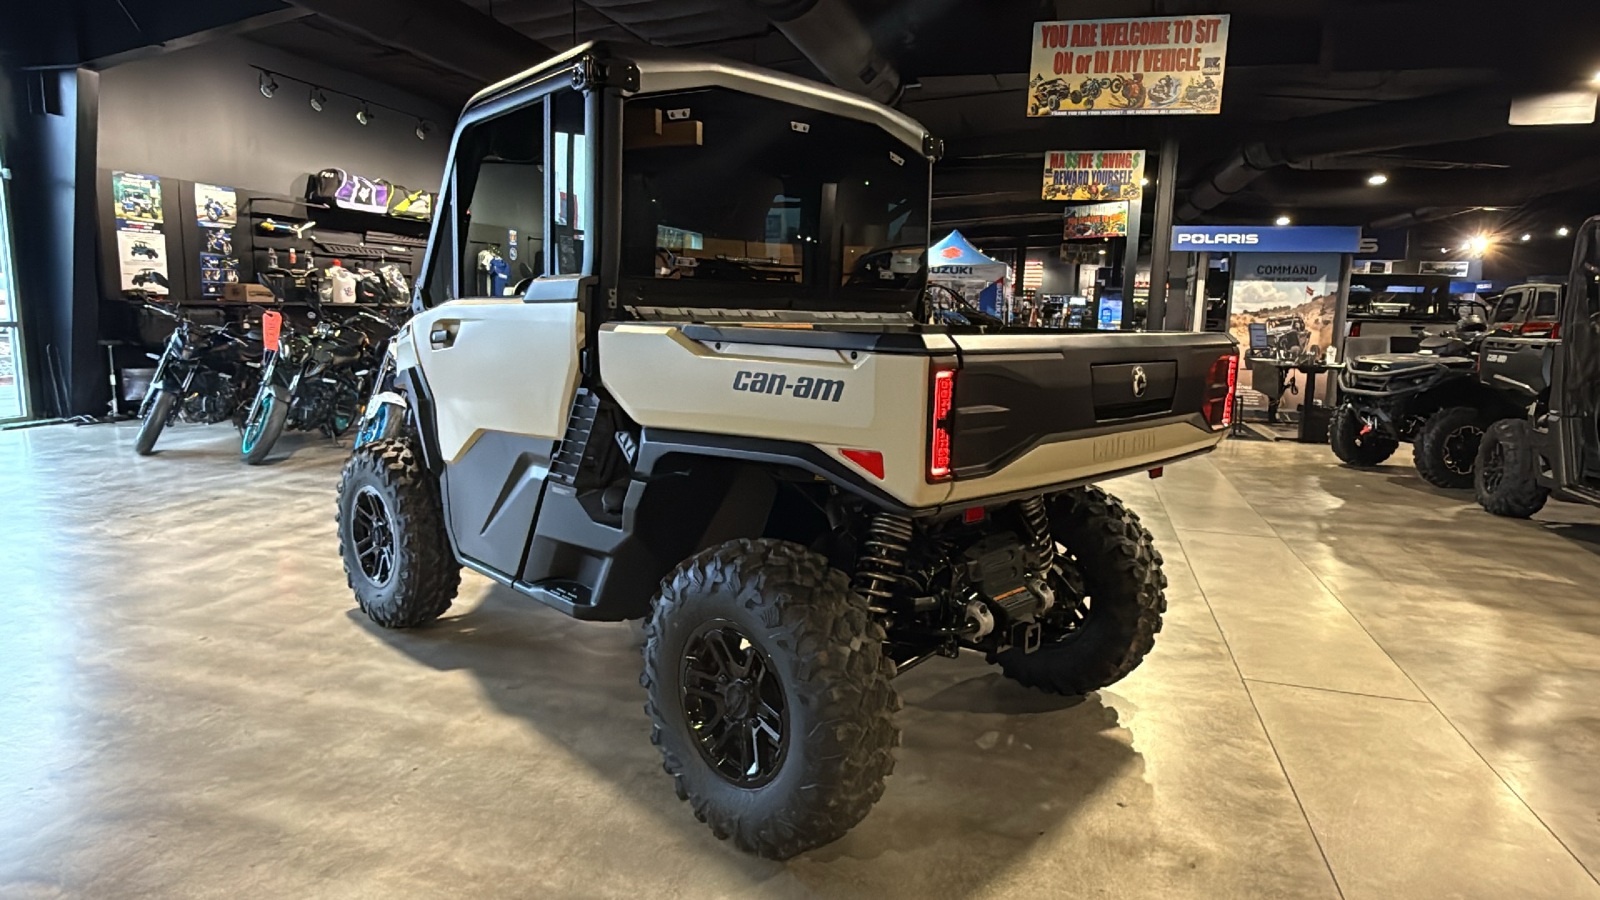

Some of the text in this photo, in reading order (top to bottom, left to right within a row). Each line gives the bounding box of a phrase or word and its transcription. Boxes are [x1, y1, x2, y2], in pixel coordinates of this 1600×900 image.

[1041, 18, 1222, 49] YOU ARE WELCOME TO SIT
[1053, 51, 1074, 75] ON
[1075, 54, 1092, 74] or
[1093, 50, 1110, 74] IN
[1111, 49, 1141, 73] ANY
[1143, 47, 1202, 73] VEHICLE
[1053, 169, 1090, 185] REWARD
[1091, 169, 1133, 185] YOURSELF
[1177, 233, 1259, 245] POLARIS
[928, 266, 974, 275] UZUKI
[1256, 264, 1318, 275] COMMAND
[732, 370, 846, 403] can-am
